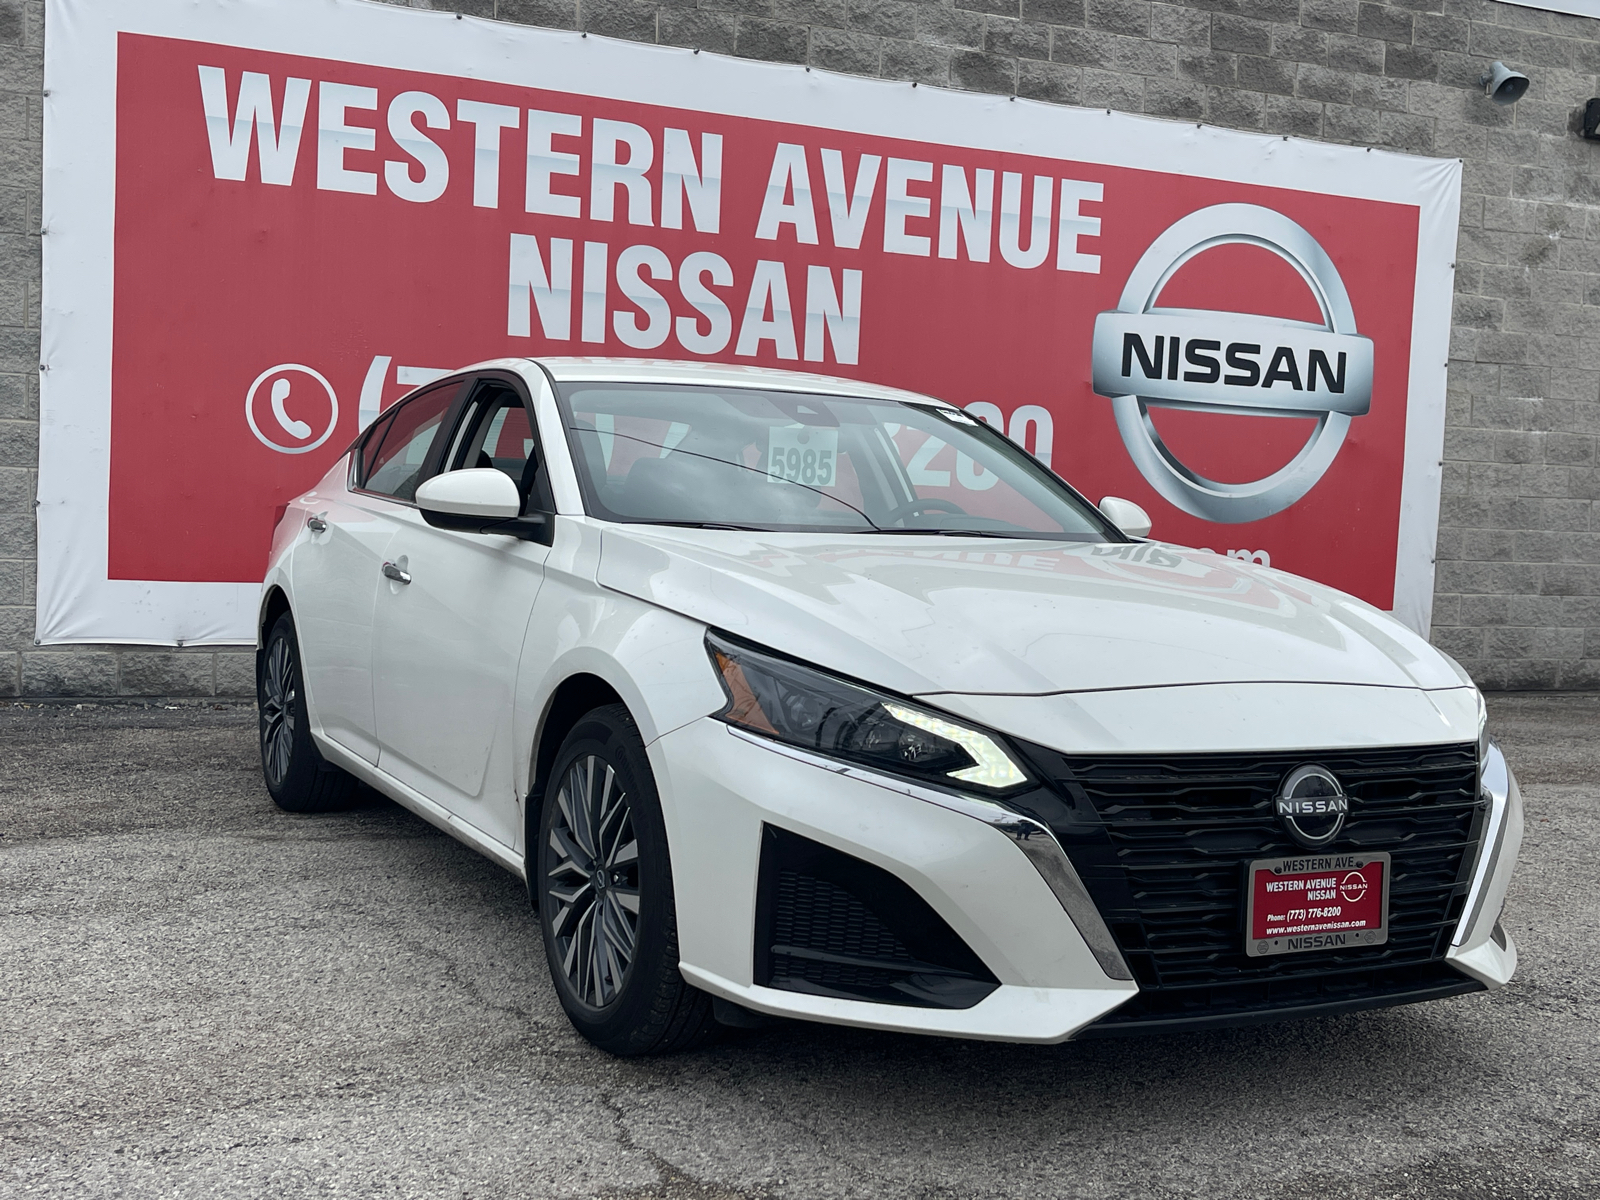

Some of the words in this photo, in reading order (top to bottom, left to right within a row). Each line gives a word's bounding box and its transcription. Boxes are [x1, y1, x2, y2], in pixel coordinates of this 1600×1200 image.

[197, 65, 723, 235] WESTERN
[756, 142, 1105, 275] AVENUE
[507, 233, 863, 366] NISSAN
[1121, 333, 1347, 394] NISSAN
[771, 447, 832, 486] 5985
[1279, 799, 1348, 814] NISSAN
[1283, 858, 1332, 872] WESTERN
[1266, 879, 1304, 892] WESTERN
[1306, 878, 1336, 890] AVENUE
[1307, 889, 1336, 901] NISSAN
[1267, 913, 1285, 922] Phone:
[1287, 909, 1306, 922] (773)
[1308, 906, 1341, 918] 776-8200
[1266, 920, 1366, 935] www.westernavenissan.com
[1287, 934, 1346, 950] NISSAN
